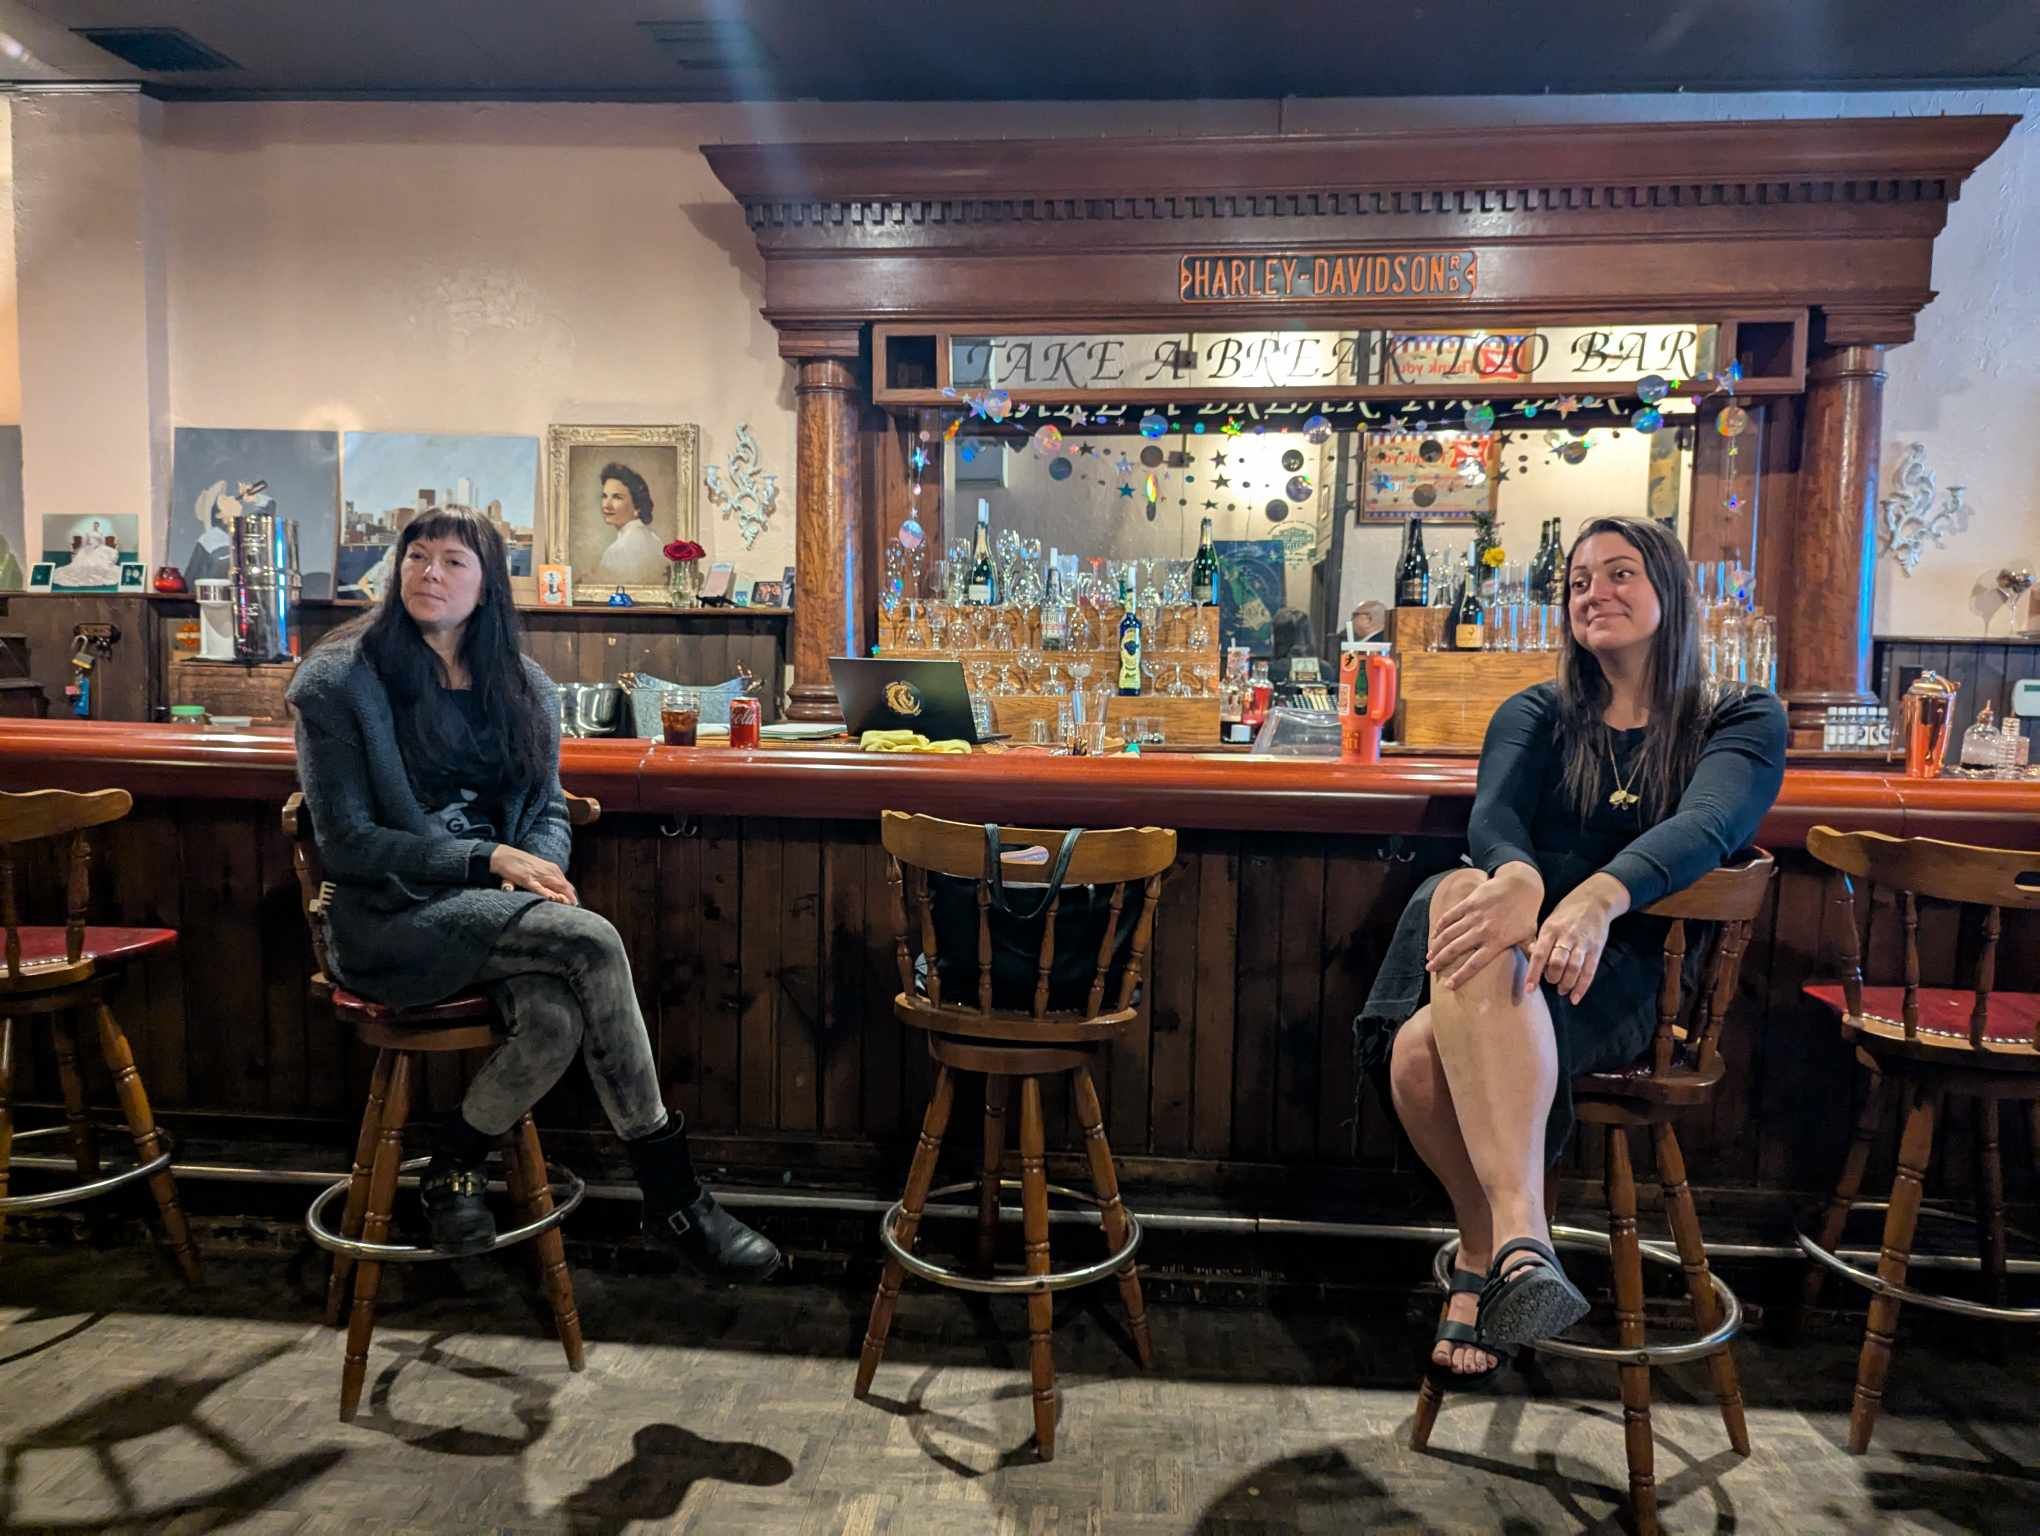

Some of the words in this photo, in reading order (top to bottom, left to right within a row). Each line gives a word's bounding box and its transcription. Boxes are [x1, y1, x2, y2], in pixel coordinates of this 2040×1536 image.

[1194, 255, 1445, 296] HARLEY-DAVIDSON
[966, 339, 1124, 388] TAKE
[1144, 340, 1186, 381] A
[1207, 335, 1416, 387] BREAK
[1437, 332, 1549, 376] TOO
[1570, 330, 1697, 381] BAR
